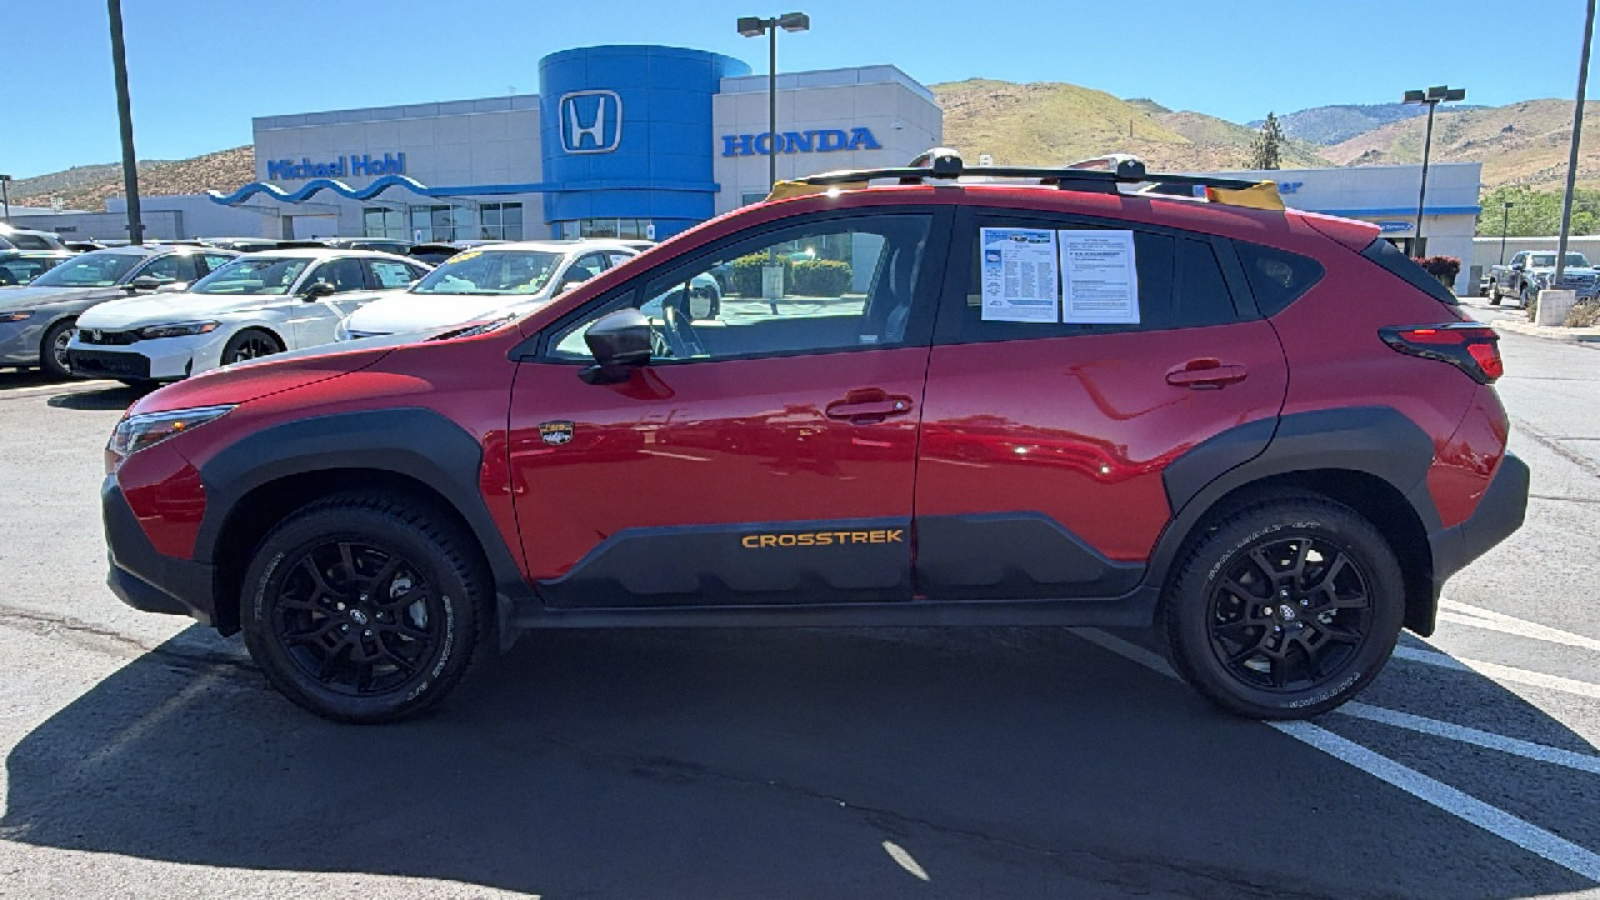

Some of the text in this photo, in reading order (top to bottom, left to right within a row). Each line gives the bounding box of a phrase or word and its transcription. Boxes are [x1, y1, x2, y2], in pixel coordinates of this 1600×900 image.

[721, 127, 882, 157] HONDA
[267, 152, 406, 180] Michael Hohl
[741, 529, 904, 549] CROSSTREK
